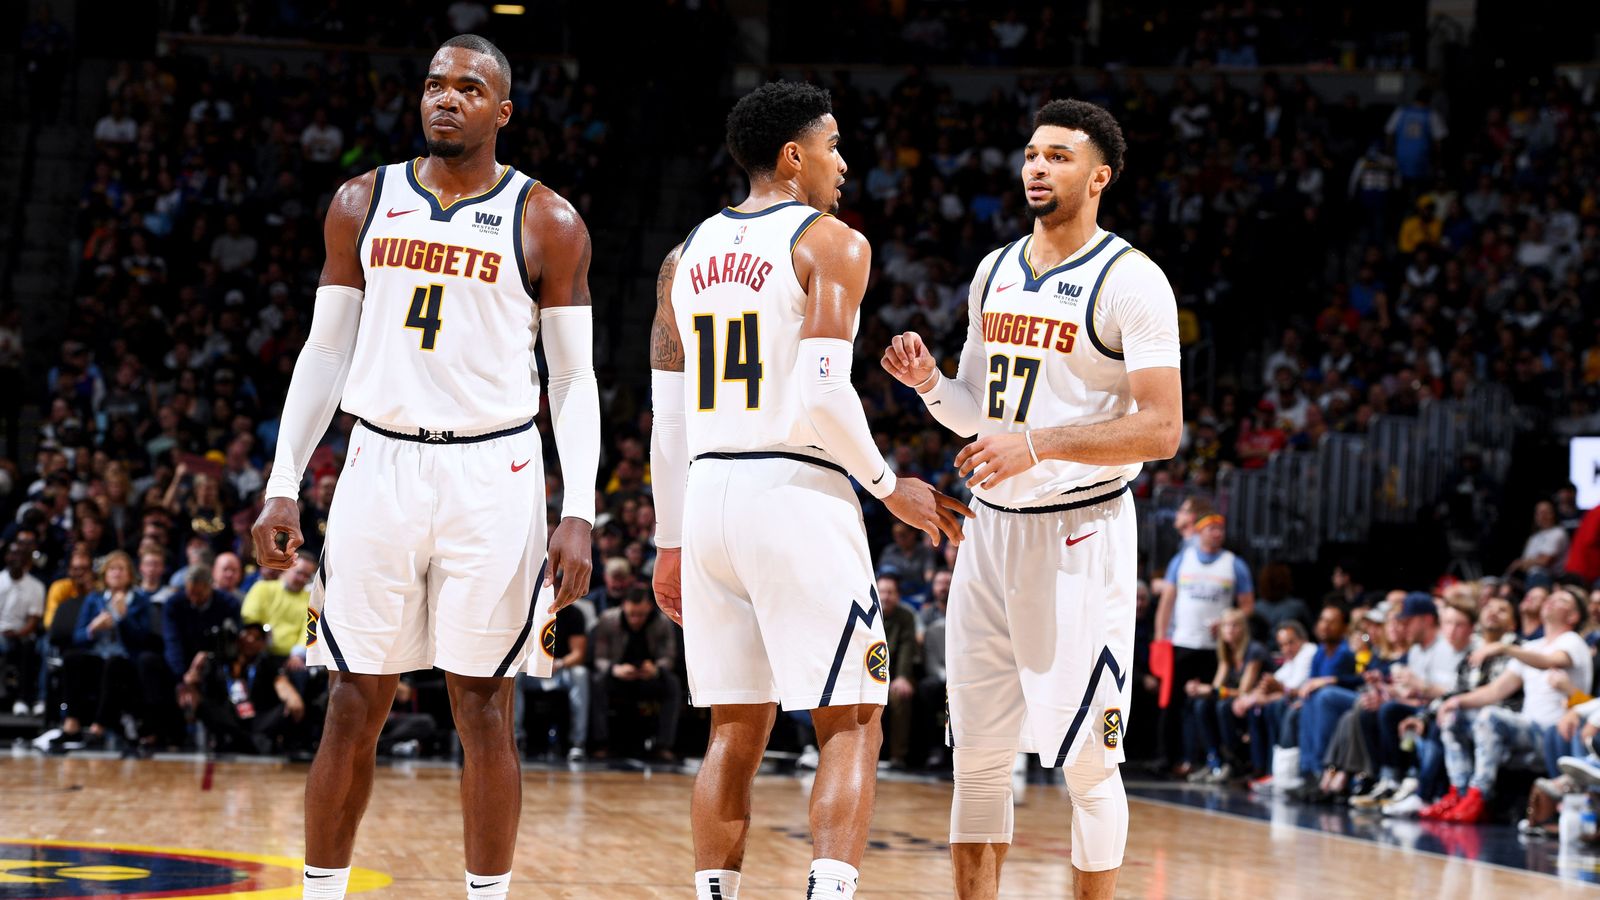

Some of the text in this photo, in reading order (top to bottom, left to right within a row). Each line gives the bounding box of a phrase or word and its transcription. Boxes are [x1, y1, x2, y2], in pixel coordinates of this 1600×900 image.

[471, 223, 500, 232] WESTERN
[475, 211, 503, 227] WU
[479, 228, 499, 236] UNION
[370, 237, 502, 284] NUGGETS
[690, 252, 774, 295] HARRIS
[1053, 294, 1079, 302] WESTERN
[1057, 281, 1083, 298] WU
[1059, 299, 1077, 307] UNION
[403, 282, 445, 352] 4
[692, 310, 764, 413] 14
[988, 353, 1042, 424] 27
